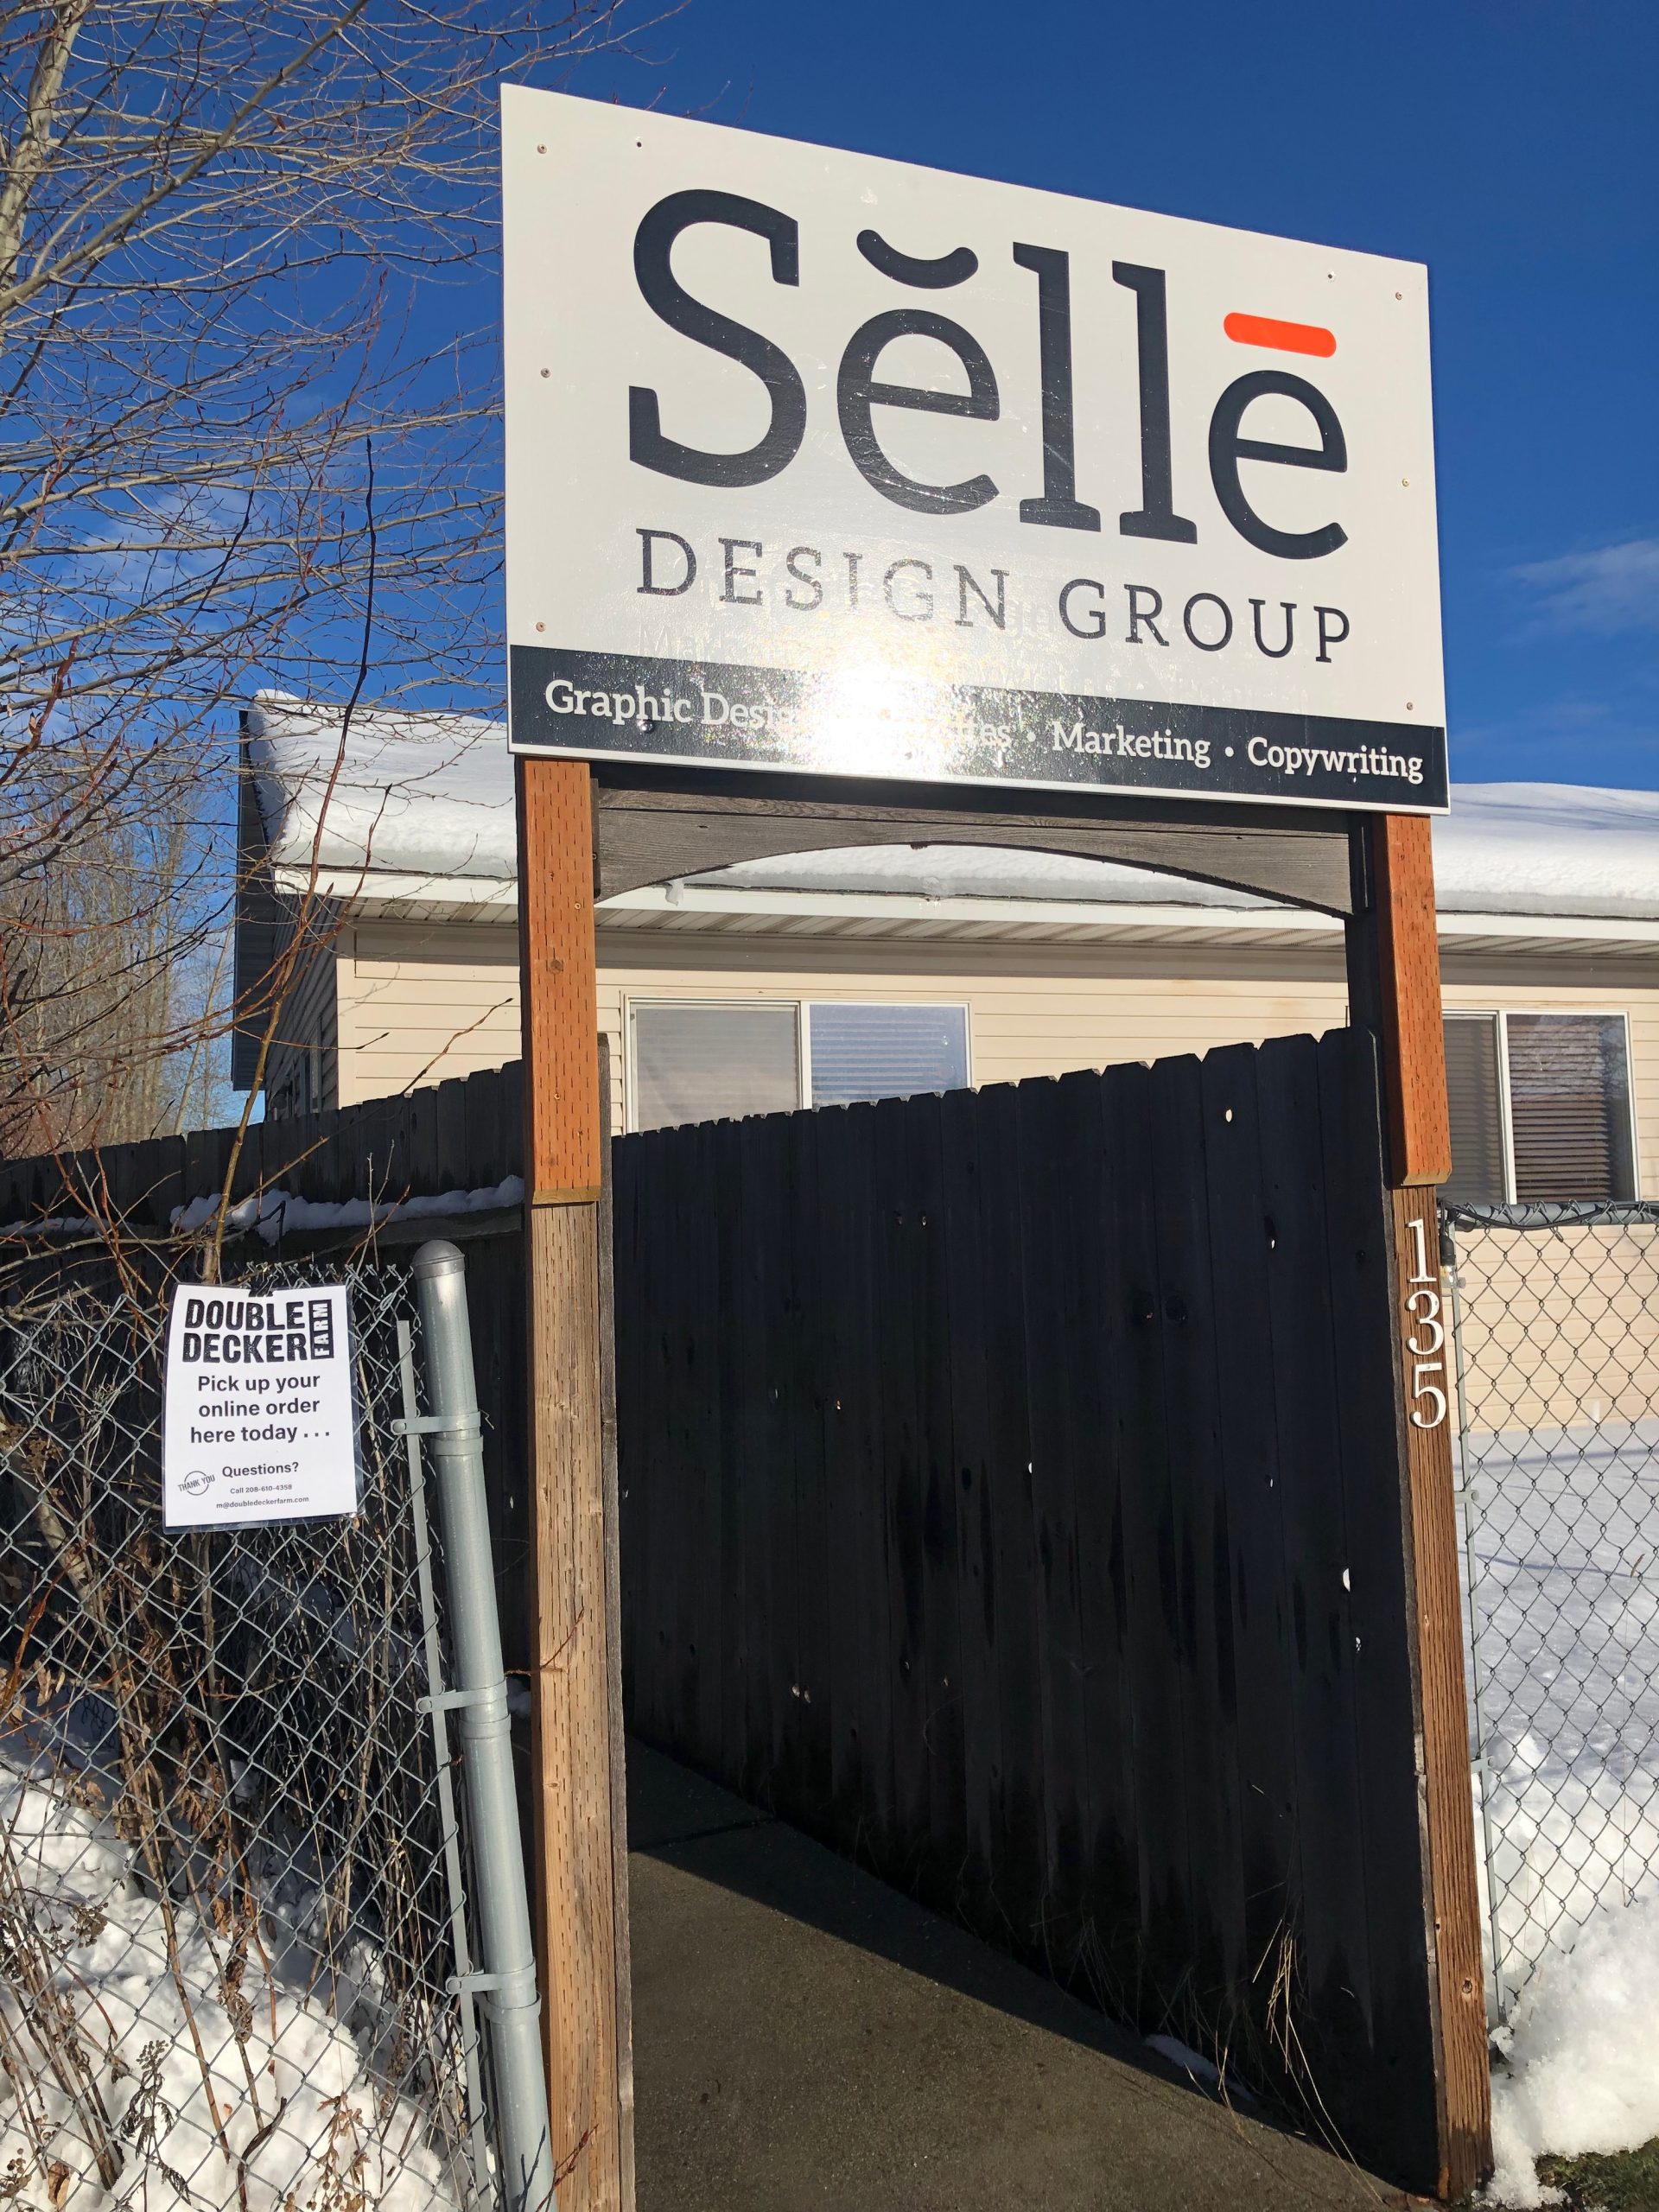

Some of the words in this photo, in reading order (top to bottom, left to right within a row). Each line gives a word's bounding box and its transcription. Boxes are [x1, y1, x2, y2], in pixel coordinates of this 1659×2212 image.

[635, 528, 1010, 631] DESIGN
[1058, 579, 1351, 663] GROUP
[544, 679, 691, 726] Graphic
[700, 691, 814, 740] Desi
[1051, 721, 1211, 768] Marketing
[1247, 736, 1424, 785] Copywriting
[184, 1299, 305, 1331] DOUBLE
[1405, 1218, 1446, 1429] 135
[312, 1302, 330, 1357] FARM
[182, 1332, 308, 1363] DECKER
[198, 1376, 239, 1391] Pick
[245, 1376, 270, 1394] up
[276, 1375, 321, 1394] your
[199, 1401, 259, 1417] online
[266, 1397, 320, 1415] order
[190, 1427, 235, 1443] here
[241, 1424, 297, 1442] today
[221, 1461, 299, 1478] Questions?
[177, 1479, 200, 1491] THANK
[201, 1474, 215, 1484] YOU
[245, 1484, 293, 1494] 208-610-4358
[216, 1497, 309, 1509] m@doubledeckerfarm.com
